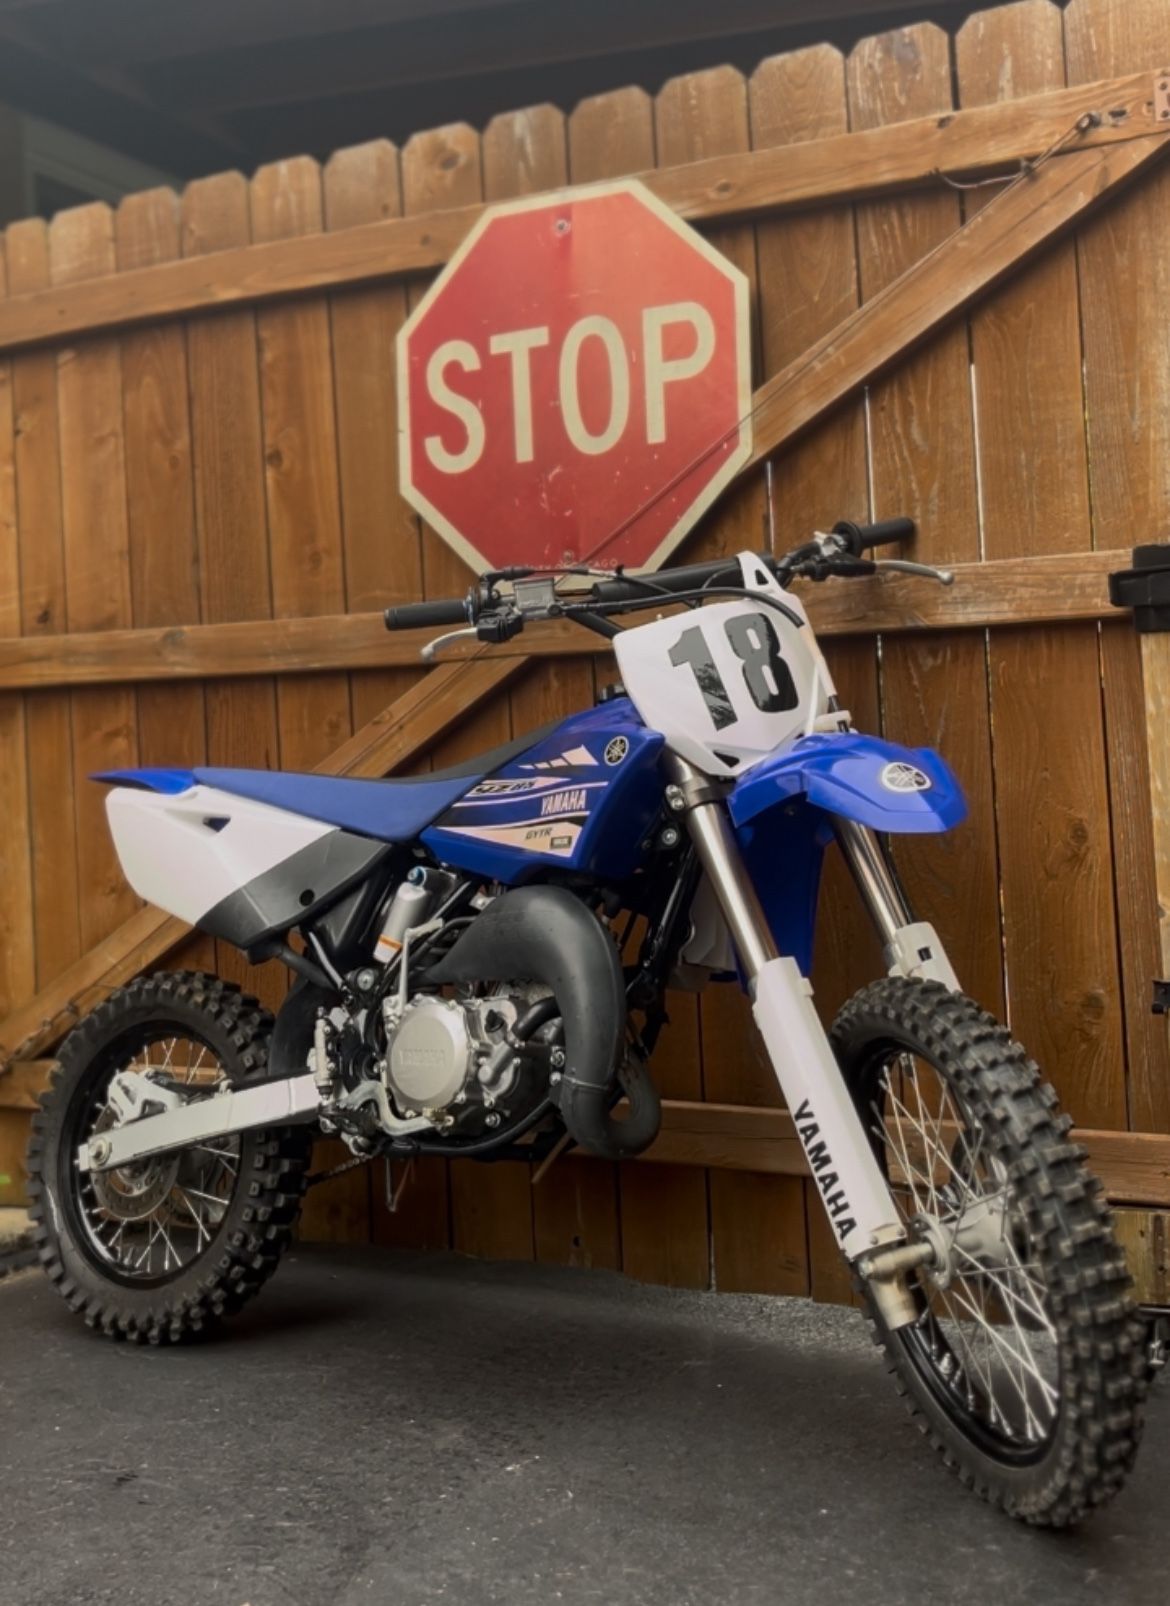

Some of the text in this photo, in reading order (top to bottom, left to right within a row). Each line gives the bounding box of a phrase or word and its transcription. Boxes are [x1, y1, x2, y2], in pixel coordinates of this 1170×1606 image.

[424, 301, 716, 474] STOP
[667, 612, 799, 731] 18
[541, 789, 586, 815] YAMAHA
[794, 1098, 857, 1241] YAMAHA
